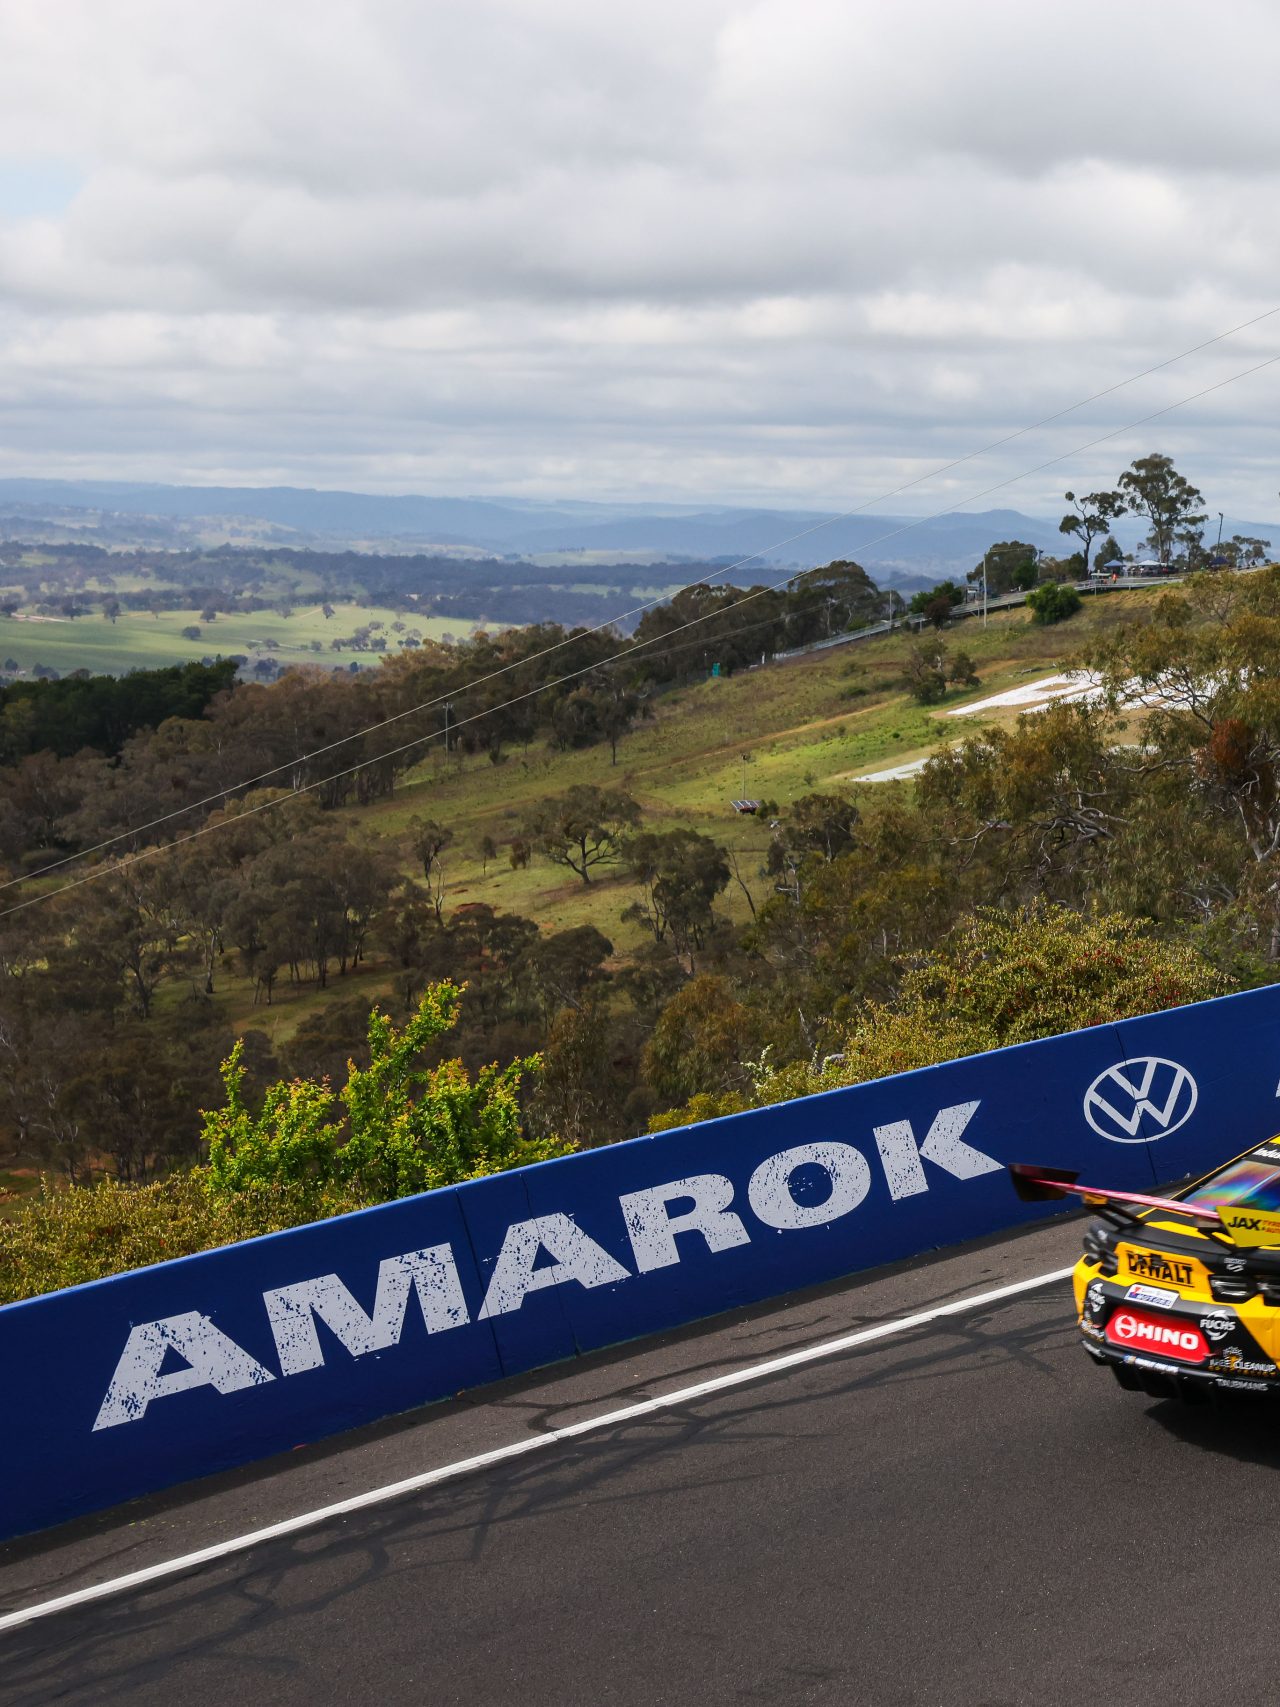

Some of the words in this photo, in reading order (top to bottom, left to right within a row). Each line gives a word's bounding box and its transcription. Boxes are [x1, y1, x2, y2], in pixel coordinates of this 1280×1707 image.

[1228, 1216, 1262, 1231] JAX
[91, 1099, 1006, 1432] AMAROK
[1200, 1318, 1236, 1331] FUCHS
[1136, 1324, 1199, 1350] HINO
